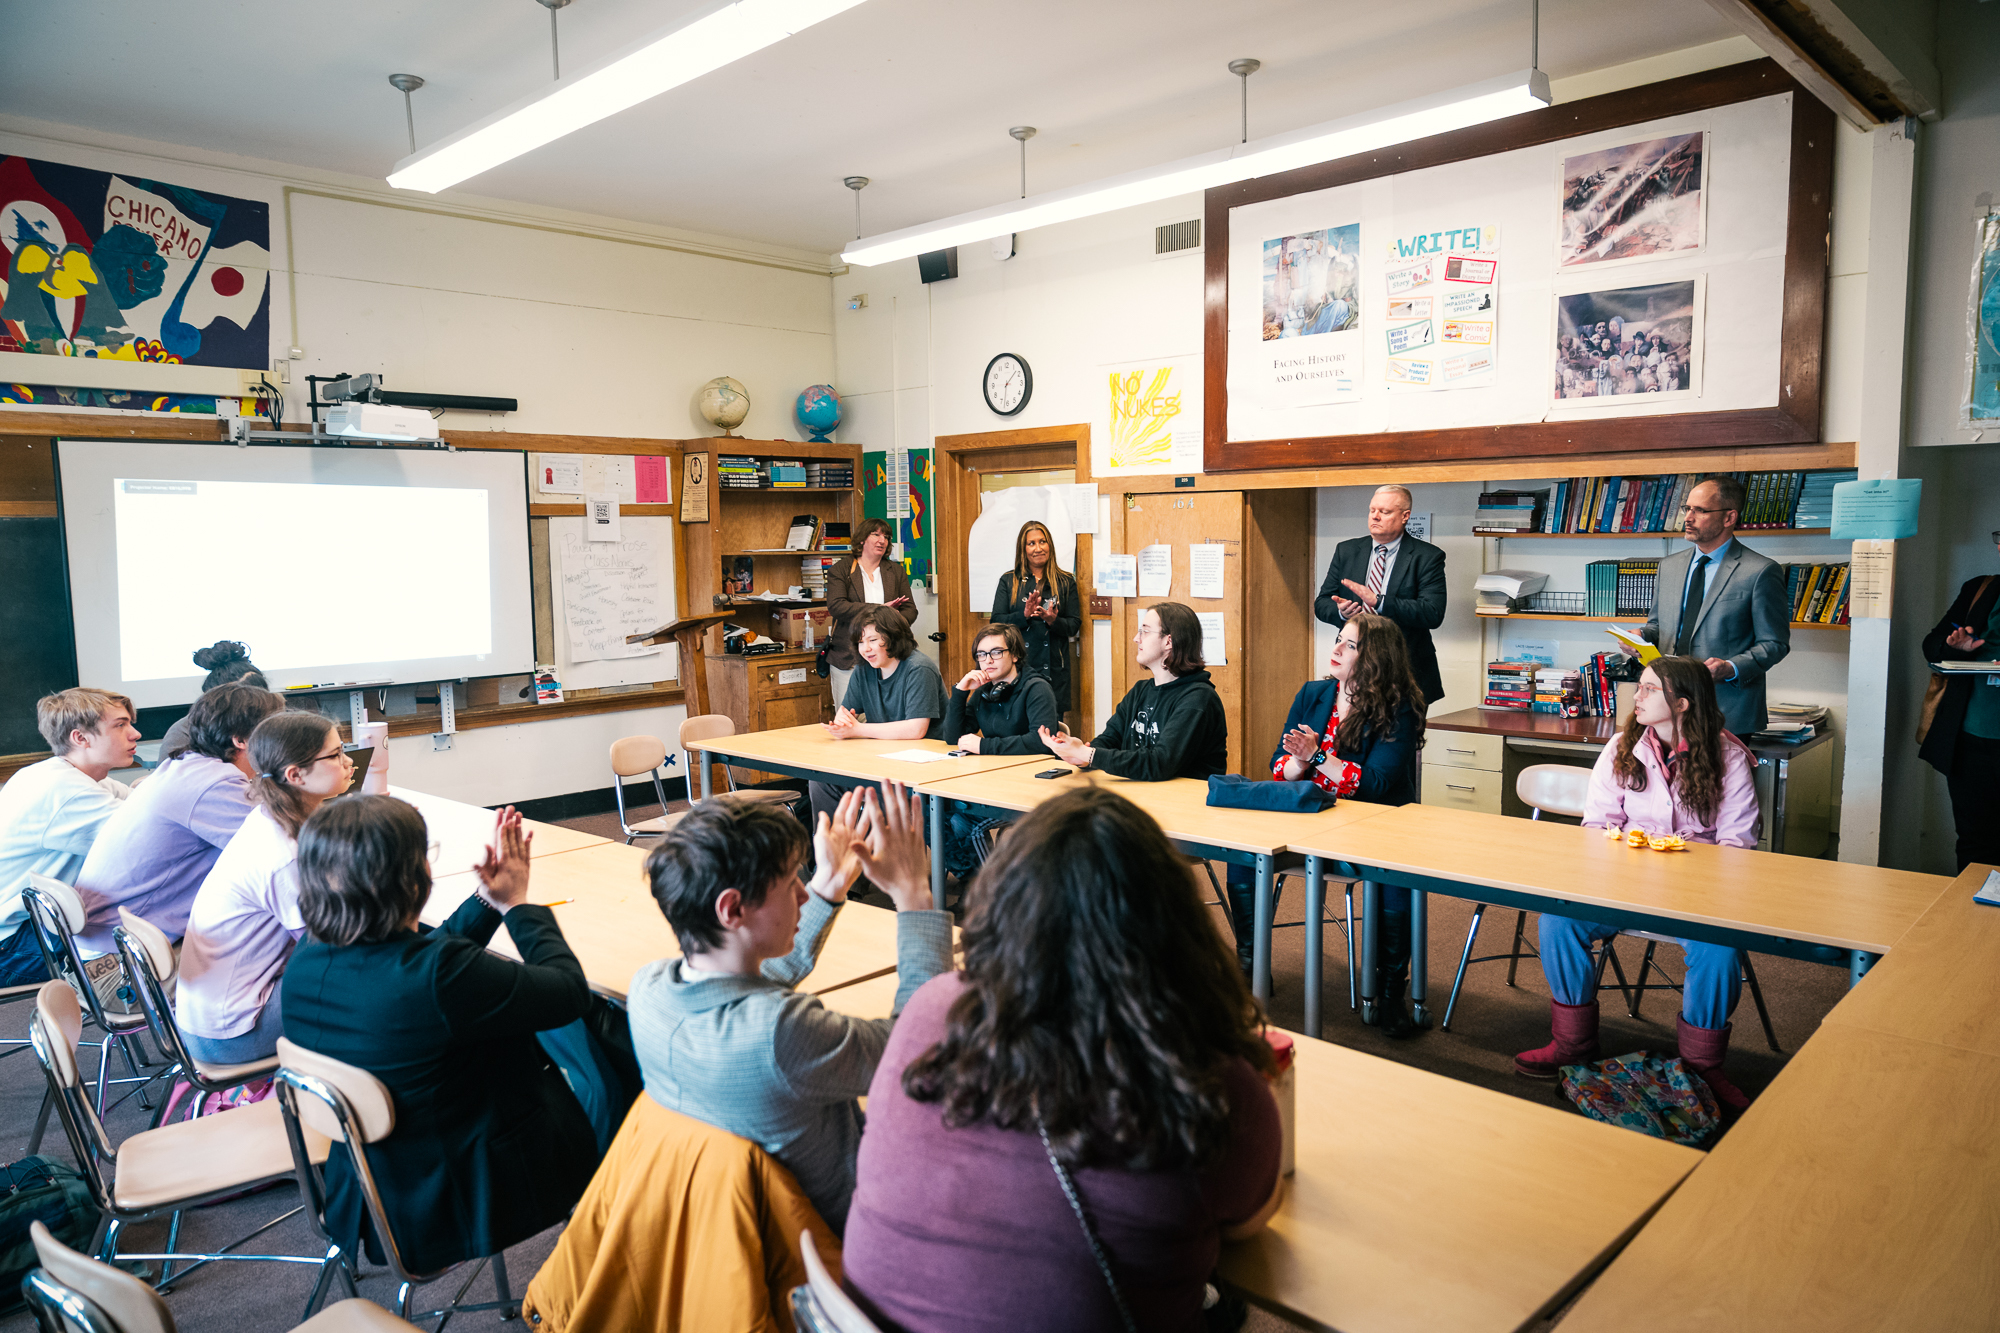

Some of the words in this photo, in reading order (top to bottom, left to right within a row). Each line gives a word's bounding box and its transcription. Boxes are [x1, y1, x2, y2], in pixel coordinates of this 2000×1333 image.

[108, 195, 202, 259] CHICANO
[1398, 228, 1480, 257] WRITE!
[1388, 270, 1407, 281] Write
[1392, 278, 1410, 288] Story
[1445, 297, 1481, 308] IMPASSIONED
[1390, 329, 1403, 338] Write
[1390, 337, 1402, 345] Song
[1112, 376, 1140, 396] NO
[1113, 396, 1179, 420] NUKES
[1173, 497, 1184, 509] 16
[1187, 497, 1194, 509] A
[584, 554, 610, 569] Class
[87, 959, 115, 980] Lee
